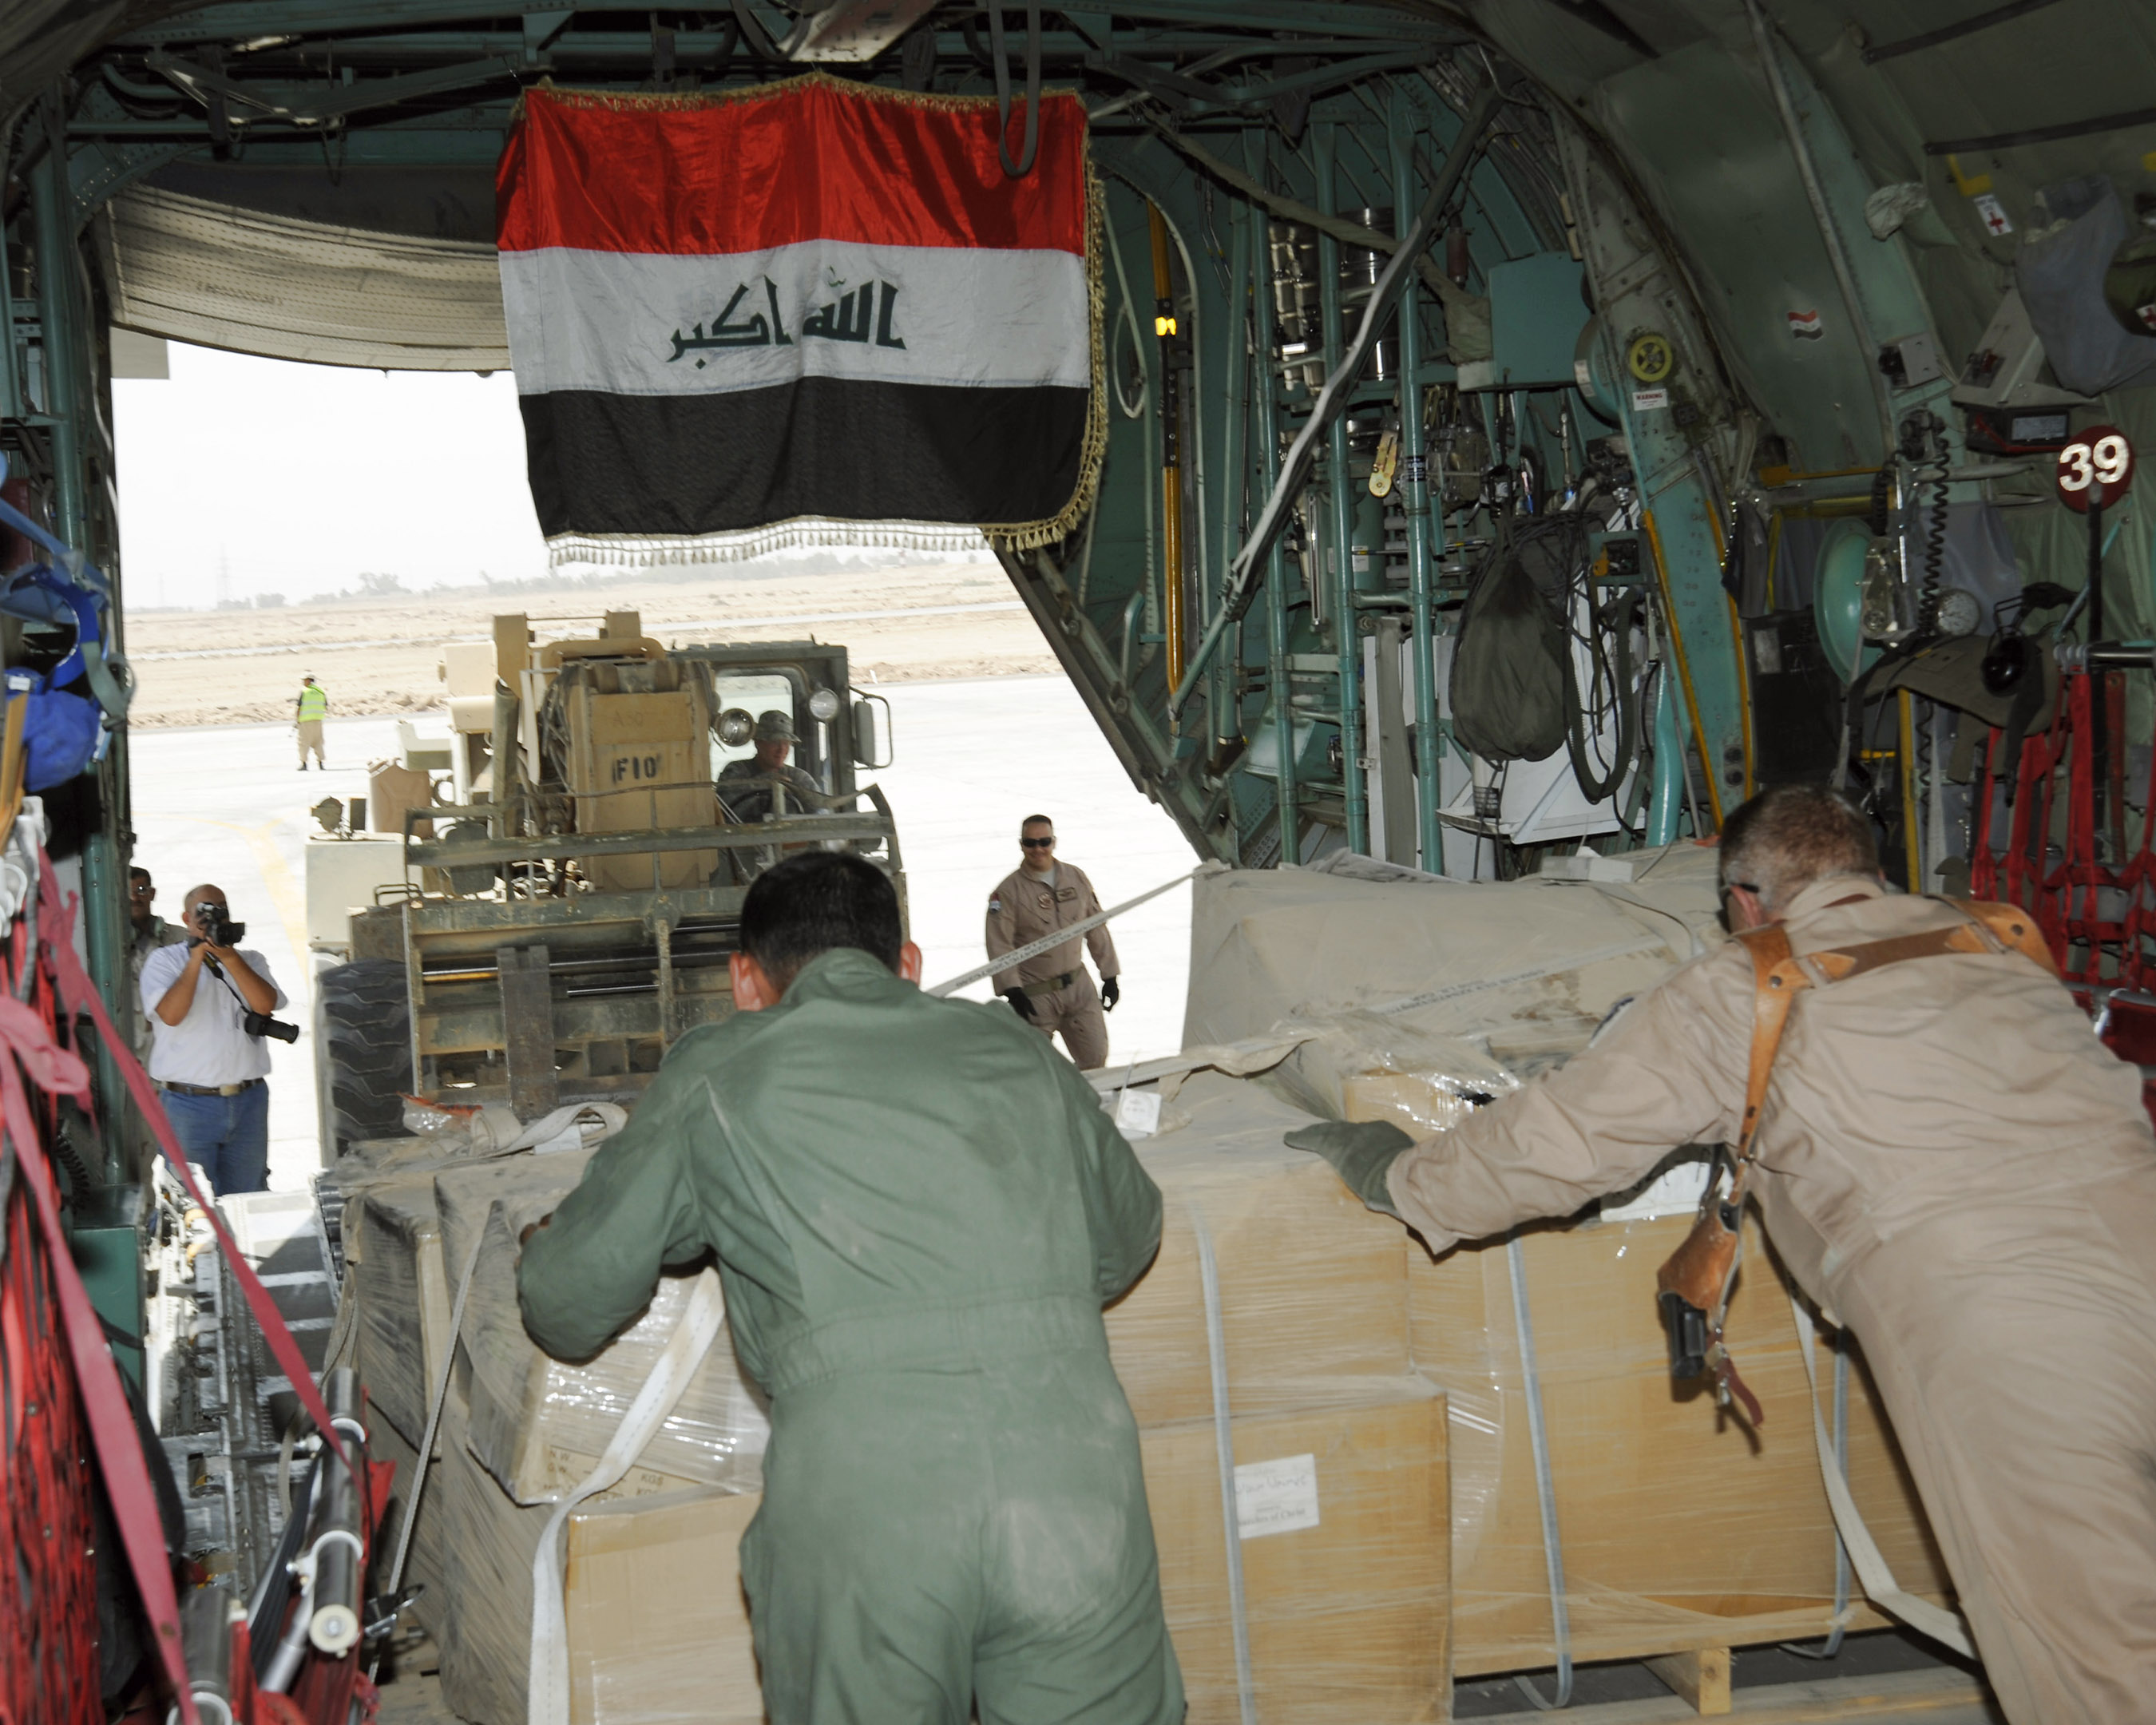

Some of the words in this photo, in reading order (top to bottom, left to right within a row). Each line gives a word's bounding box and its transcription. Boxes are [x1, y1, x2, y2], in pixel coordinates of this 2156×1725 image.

[2059, 434, 2130, 492] 39
[616, 755, 657, 782] F10
[641, 1473, 664, 1485] KGS
